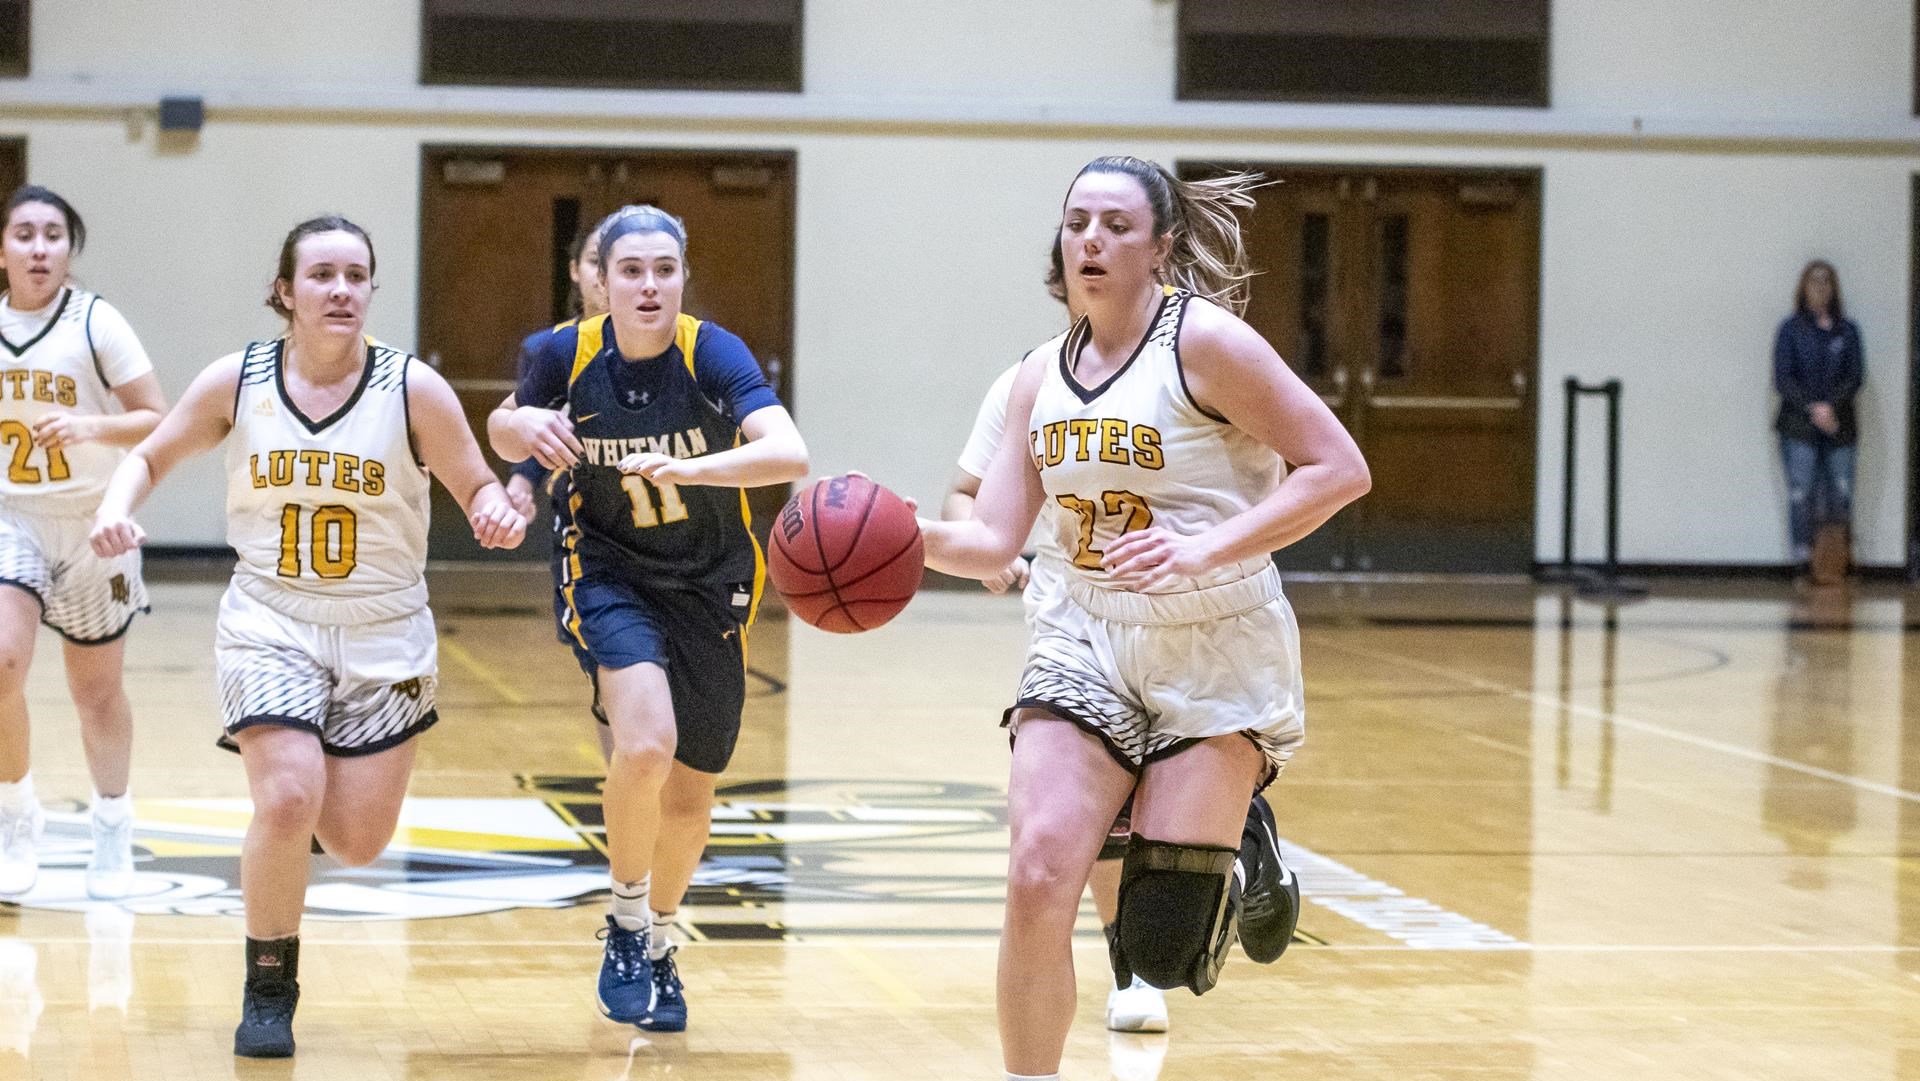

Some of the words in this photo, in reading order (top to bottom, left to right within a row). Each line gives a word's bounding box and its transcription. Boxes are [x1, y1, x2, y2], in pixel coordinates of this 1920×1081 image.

[0, 367, 77, 407] TES
[580, 426, 708, 467] WHITMAN
[1030, 417, 1165, 472] LUTES
[249, 449, 386, 497] LUTES
[620, 475, 689, 529] 11
[276, 503, 357, 579] 10
